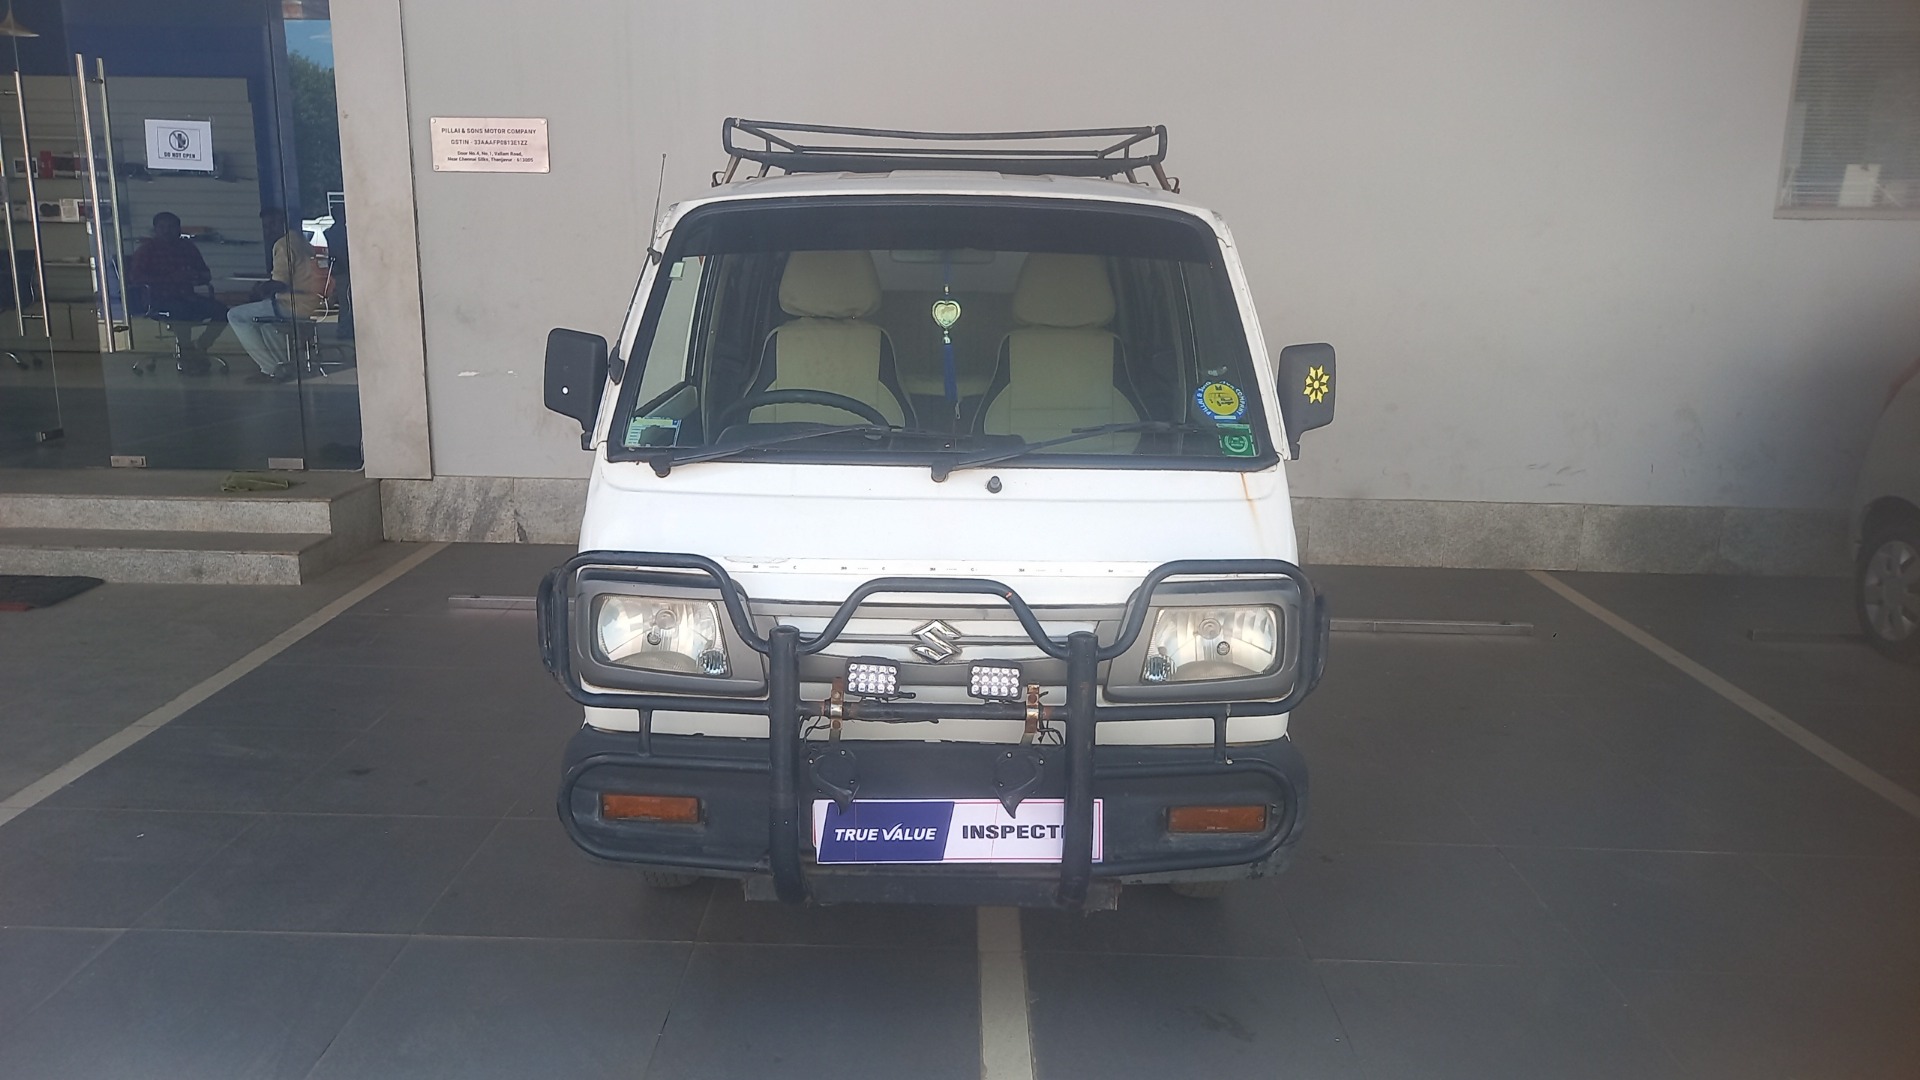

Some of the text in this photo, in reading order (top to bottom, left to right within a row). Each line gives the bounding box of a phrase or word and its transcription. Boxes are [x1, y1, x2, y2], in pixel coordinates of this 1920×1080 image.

[834, 822, 1064, 842] TRUE VALUE INSPECT
